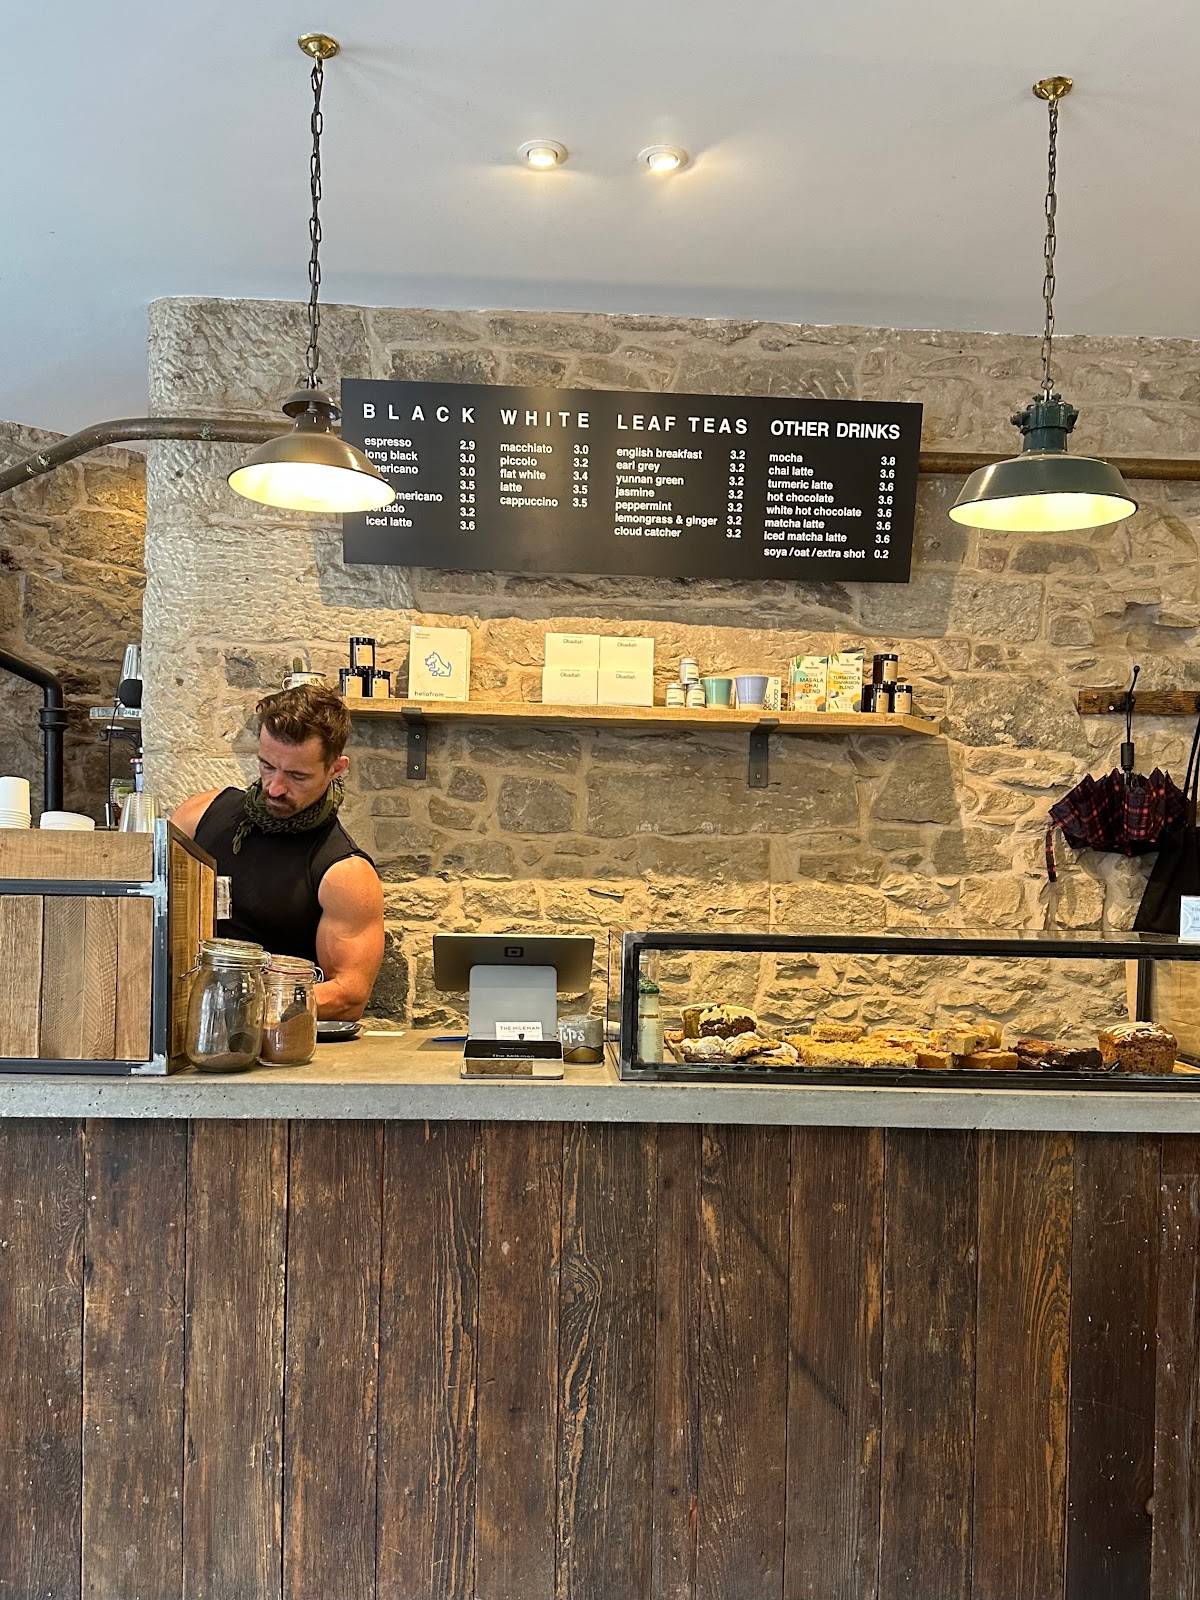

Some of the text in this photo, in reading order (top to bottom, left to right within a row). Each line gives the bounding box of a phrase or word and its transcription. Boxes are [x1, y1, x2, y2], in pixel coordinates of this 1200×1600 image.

[363, 403, 475, 424] BLACK
[500, 409, 589, 429] WHITE
[617, 414, 748, 435] LEAF TEAS
[770, 419, 901, 440] OTHER DRINKS
[364, 437, 476, 450] espresso 2.9
[500, 442, 589, 455] macchiato 3.0
[389, 450, 418, 461] black
[460, 453, 476, 463] 3.0
[616, 446, 746, 460] english breakfast 3.2
[768, 453, 896, 466] mocha 3.8
[500, 455, 589, 468] piccolo 3.2
[616, 460, 745, 474] earl grey 3.2
[460, 466, 476, 477] 3.0
[500, 469, 588, 481] flat white 3.4
[767, 466, 895, 479] chai latte 3.6
[460, 480, 476, 490] 3.5
[615, 474, 744, 487] yunnan green 3.2
[767, 479, 894, 492] turmeric latte 3.6
[500, 481, 588, 495] latte 3.5
[614, 486, 743, 500] jasmine 3.2
[396, 490, 476, 504] mericano 3.5
[500, 497, 588, 508] cappuccino 3.5
[766, 491, 894, 505] hot chocolate 3.6
[460, 507, 476, 517] 3.2
[615, 500, 743, 513] peppermint 3.2
[765, 504, 892, 518] white hot chocolate 3.6
[365, 515, 476, 531] iced latte 3.6
[614, 513, 743, 528] lemongrass & ginger 3.2
[764, 518, 891, 531] matcha latte 3.6
[613, 526, 742, 538] cloud catcher 3.2
[763, 530, 890, 544] iced matcha latte 3.6
[842, 549, 866, 558] shot
[873, 549, 889, 559] 0.2
